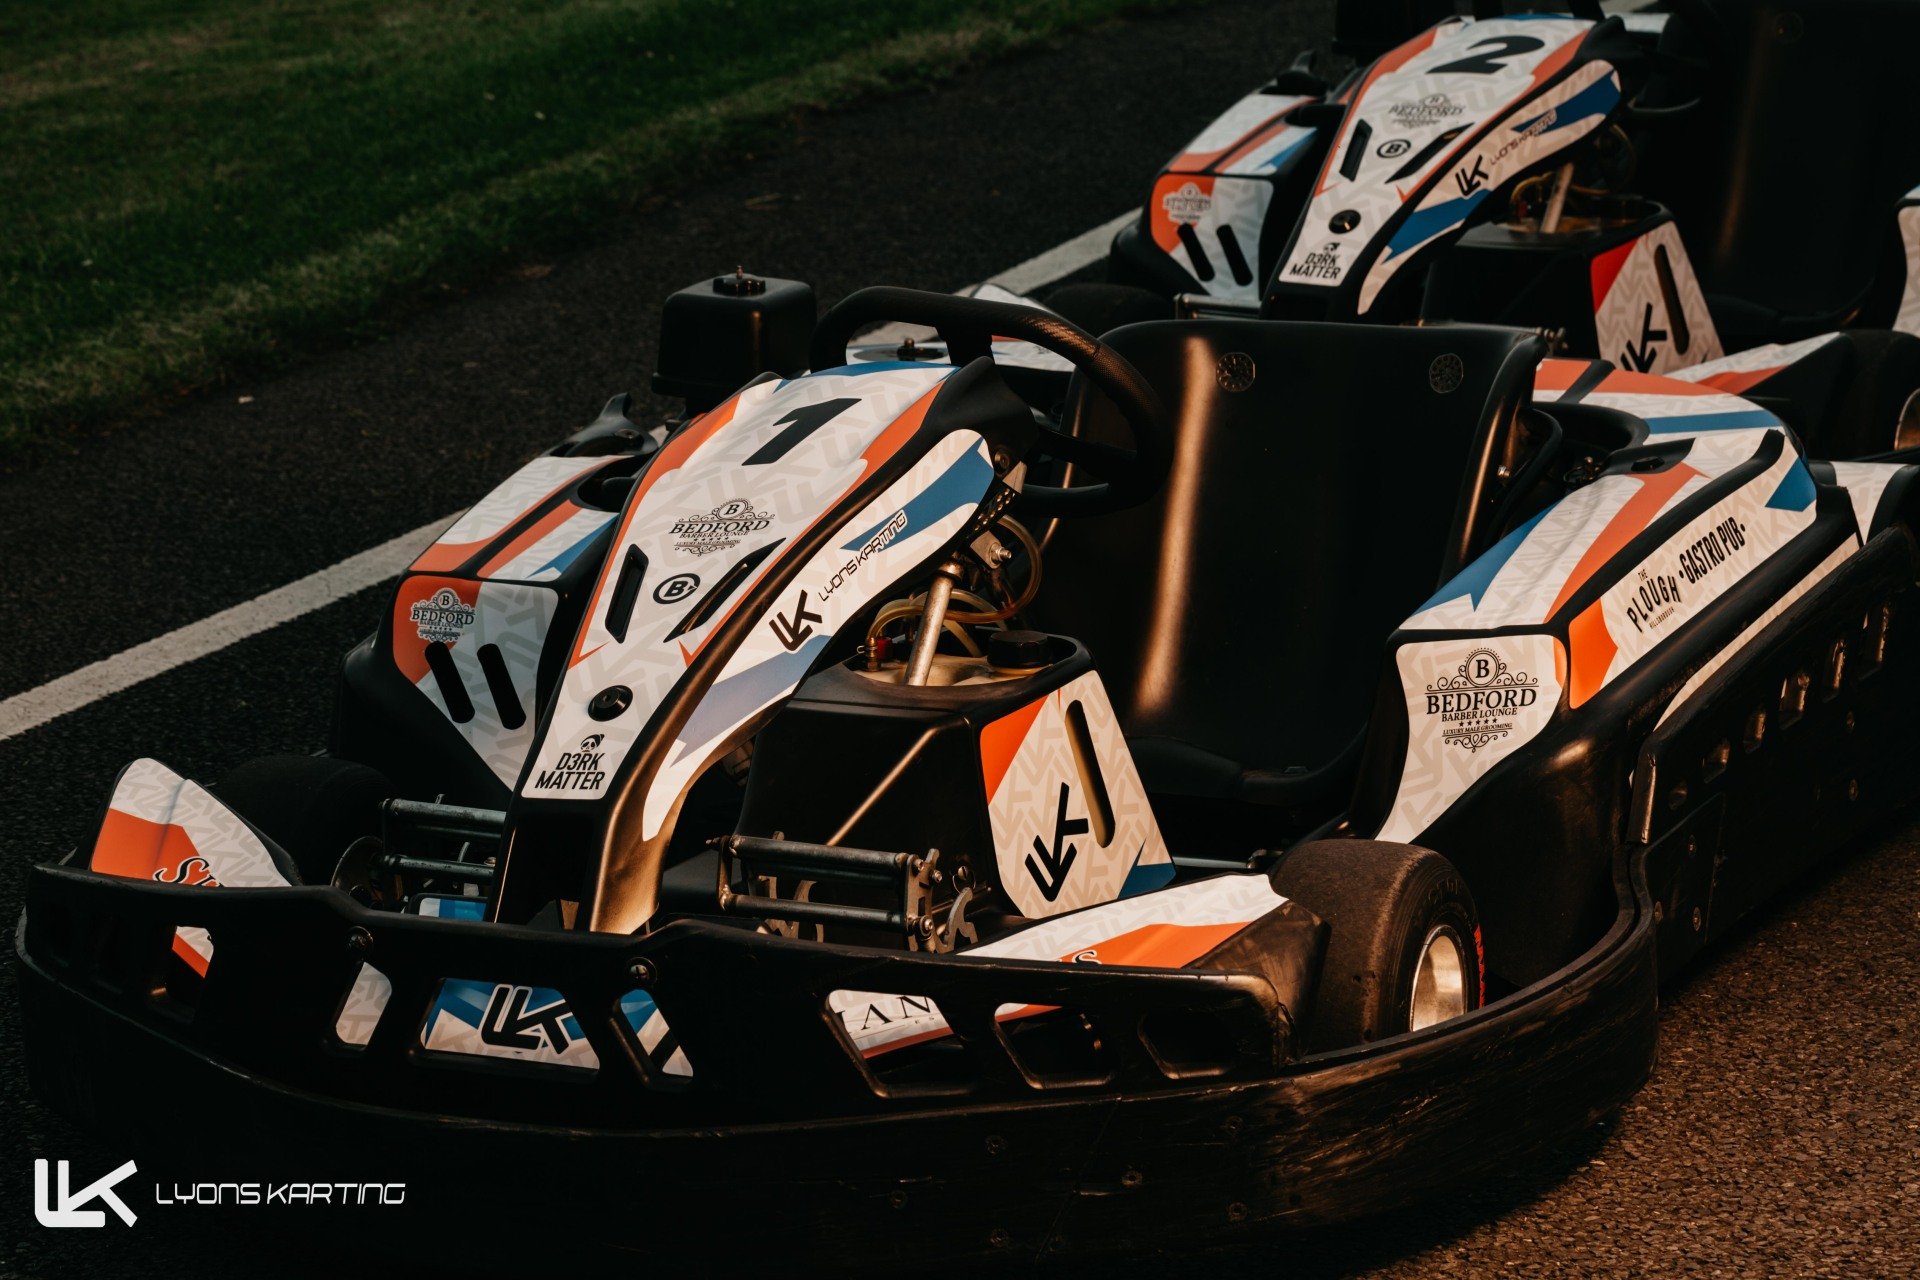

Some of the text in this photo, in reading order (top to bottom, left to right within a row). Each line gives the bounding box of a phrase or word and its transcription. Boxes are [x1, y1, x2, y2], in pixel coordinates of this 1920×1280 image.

[1424, 35, 1545, 74] 2
[1289, 263, 1341, 279] MATTER
[741, 398, 862, 466] 1
[723, 504, 740, 516] B
[669, 520, 770, 534] BEDFORD
[714, 530, 750, 538] LOUNGE
[818, 511, 907, 602] LYONS KARTING
[441, 595, 450, 605] B
[1626, 575, 1682, 633] PLOUGH
[412, 609, 475, 625] BEDFORD
[1475, 659, 1490, 678] B
[1426, 688, 1537, 715] BEDFORD
[1441, 707, 1518, 722] BARBER LOUNGE
[1480, 722, 1513, 731] GROOMING
[556, 752, 606, 771] D3RK
[534, 770, 606, 790] MATTER
